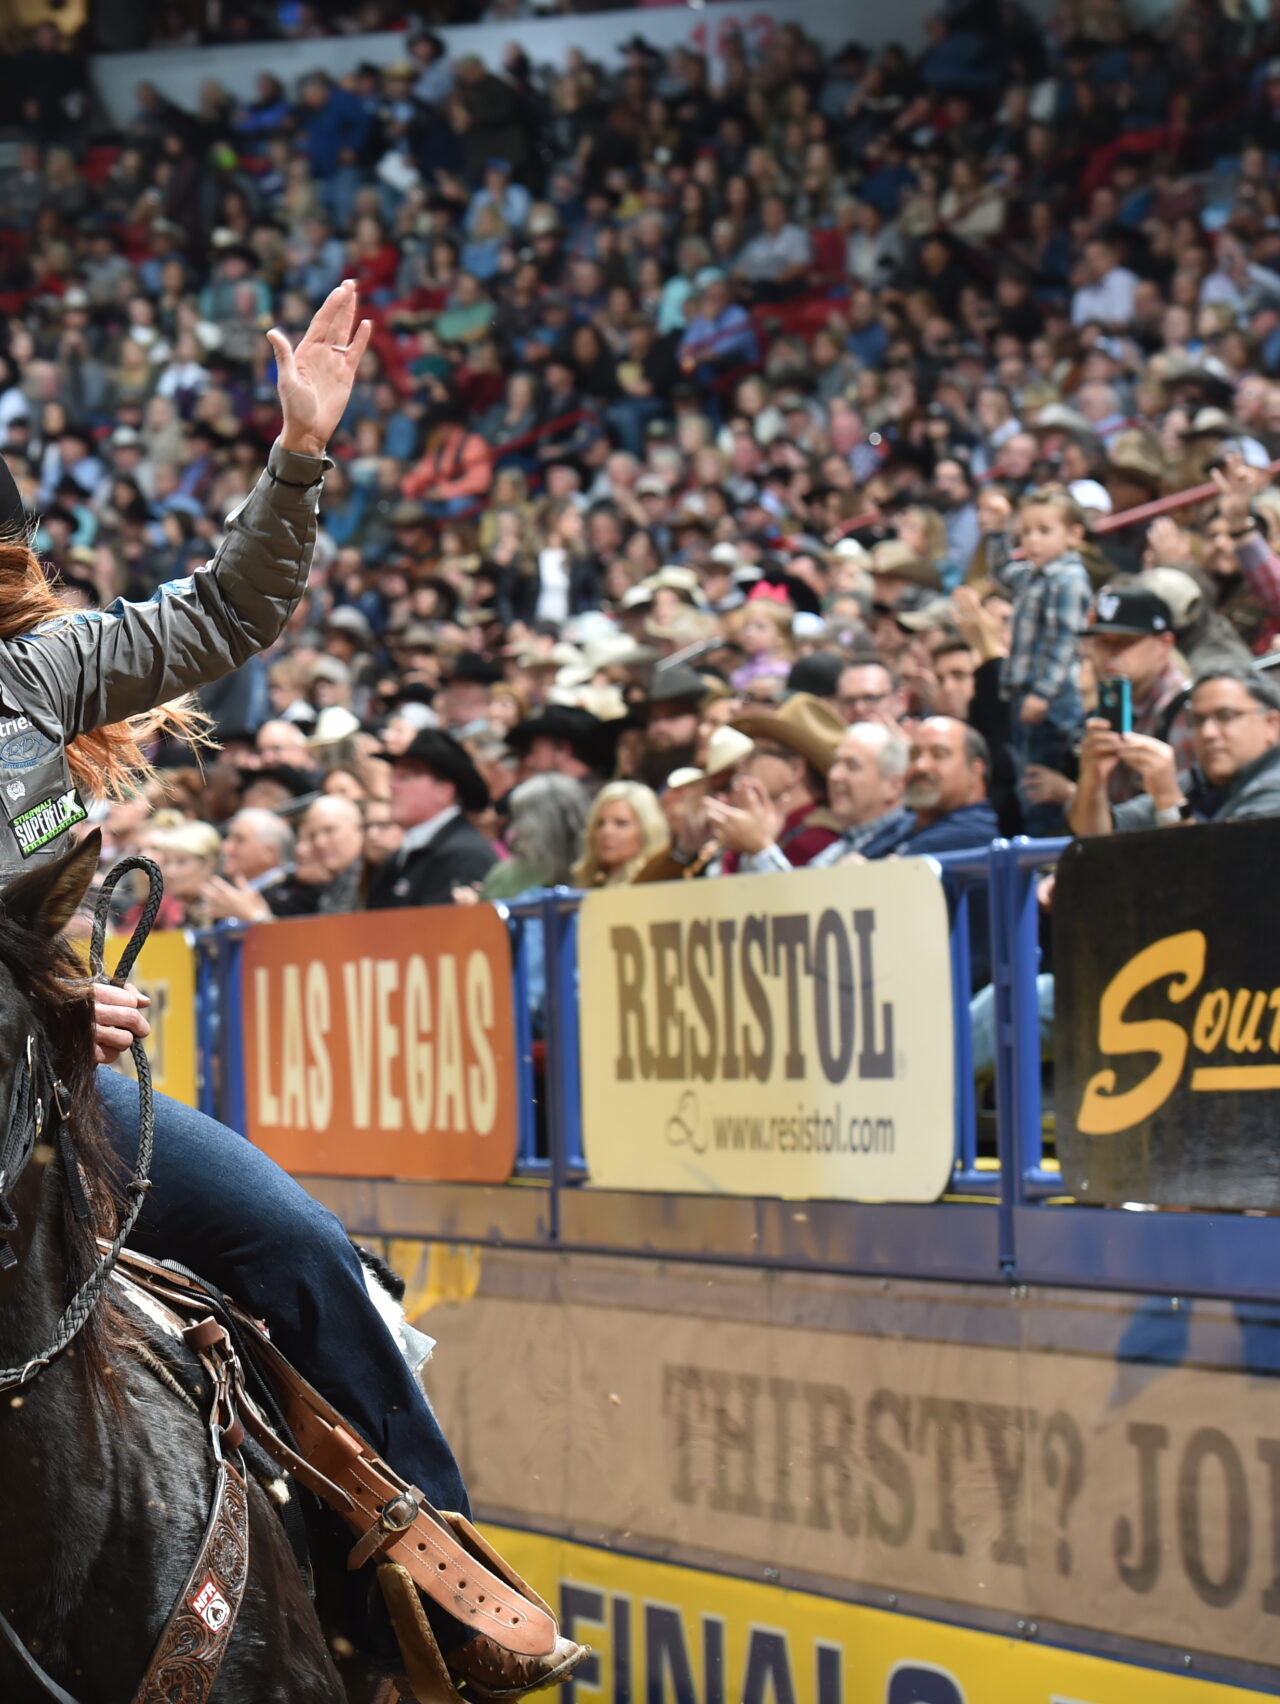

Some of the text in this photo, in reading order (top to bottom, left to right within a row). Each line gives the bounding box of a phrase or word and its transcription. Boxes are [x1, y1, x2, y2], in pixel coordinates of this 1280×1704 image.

[13, 799, 52, 827] STIERWALT
[15, 788, 85, 848] SUPERFLEX
[609, 908, 896, 1085] RESISTOL
[254, 959, 333, 1132] LAS
[342, 949, 498, 1136] VEGAS
[712, 1103, 896, 1155] www.resistol.com
[660, 1361, 1086, 1578] THIRSTY?
[192, 1581, 218, 1615] NFR
